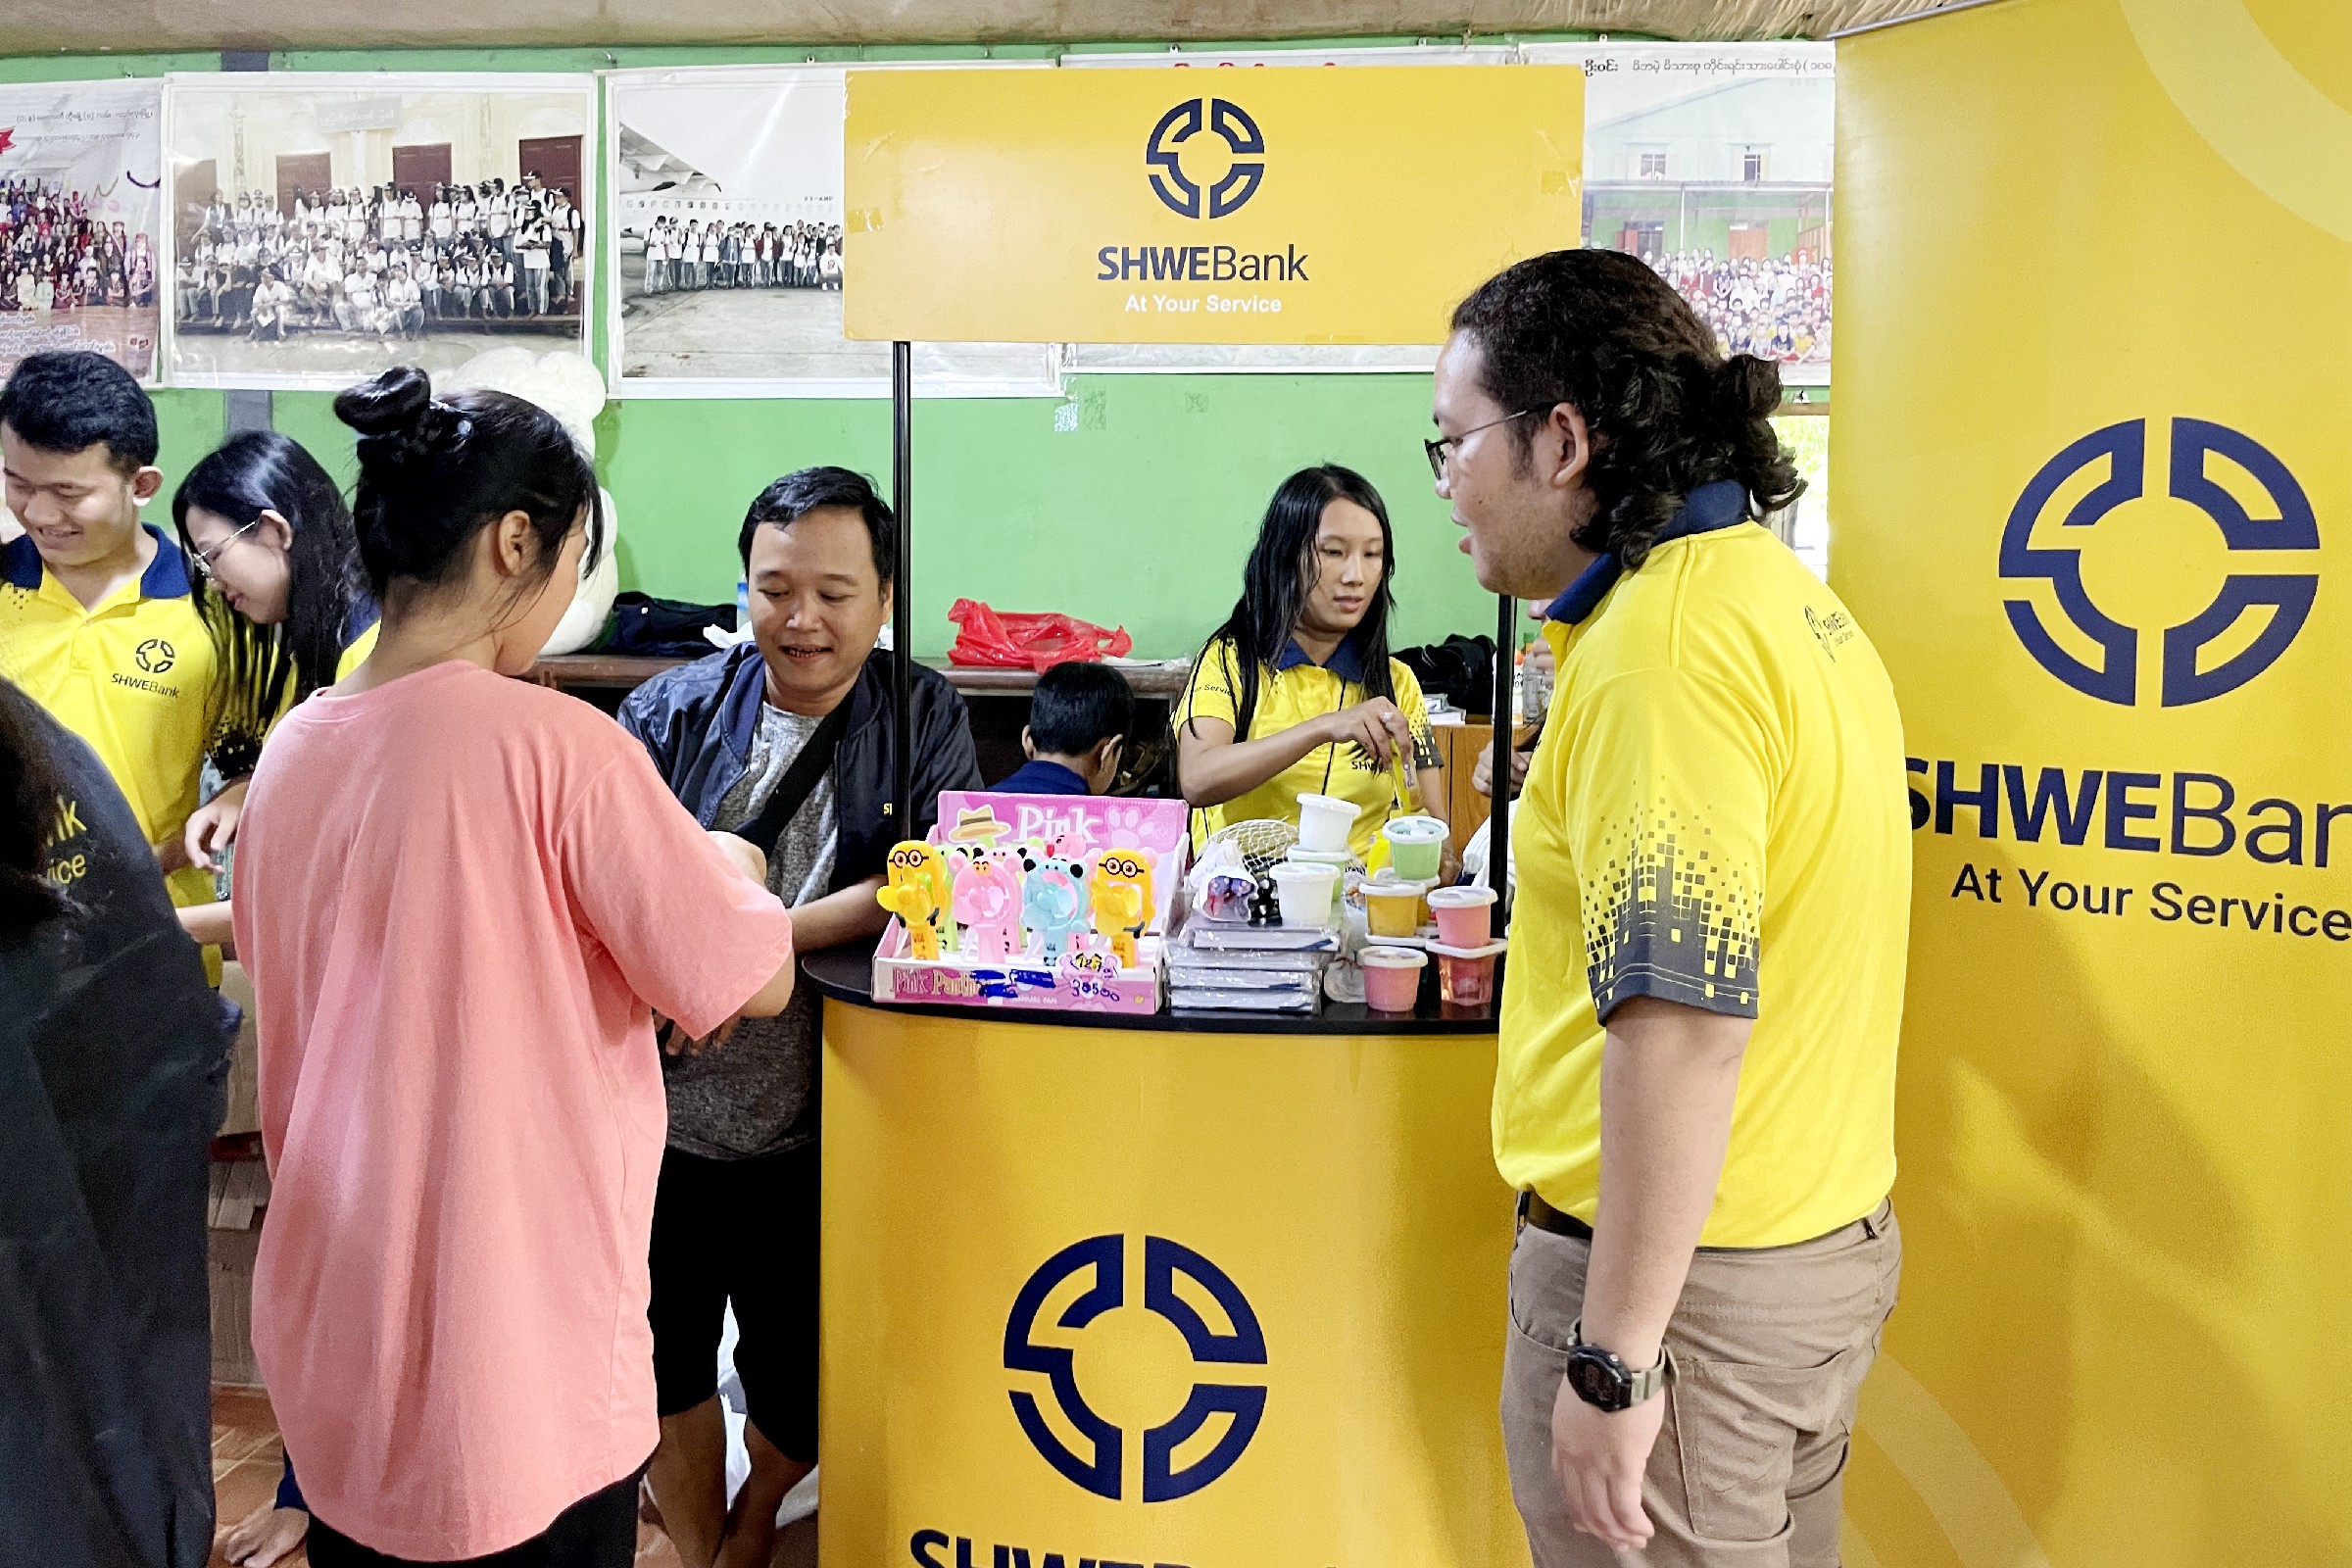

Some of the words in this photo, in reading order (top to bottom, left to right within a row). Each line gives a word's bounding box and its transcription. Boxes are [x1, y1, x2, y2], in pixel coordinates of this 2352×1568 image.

[1097, 243, 1309, 281] SHWEBank
[1125, 294, 1148, 313] At
[1152, 294, 1200, 313] Your
[1205, 294, 1282, 313] Service
[111, 672, 180, 699] SHWEBank
[1011, 805, 1102, 844] Pink
[1950, 862, 2002, 905] At
[2018, 867, 2134, 917] Your
[2149, 881, 2352, 942] Service
